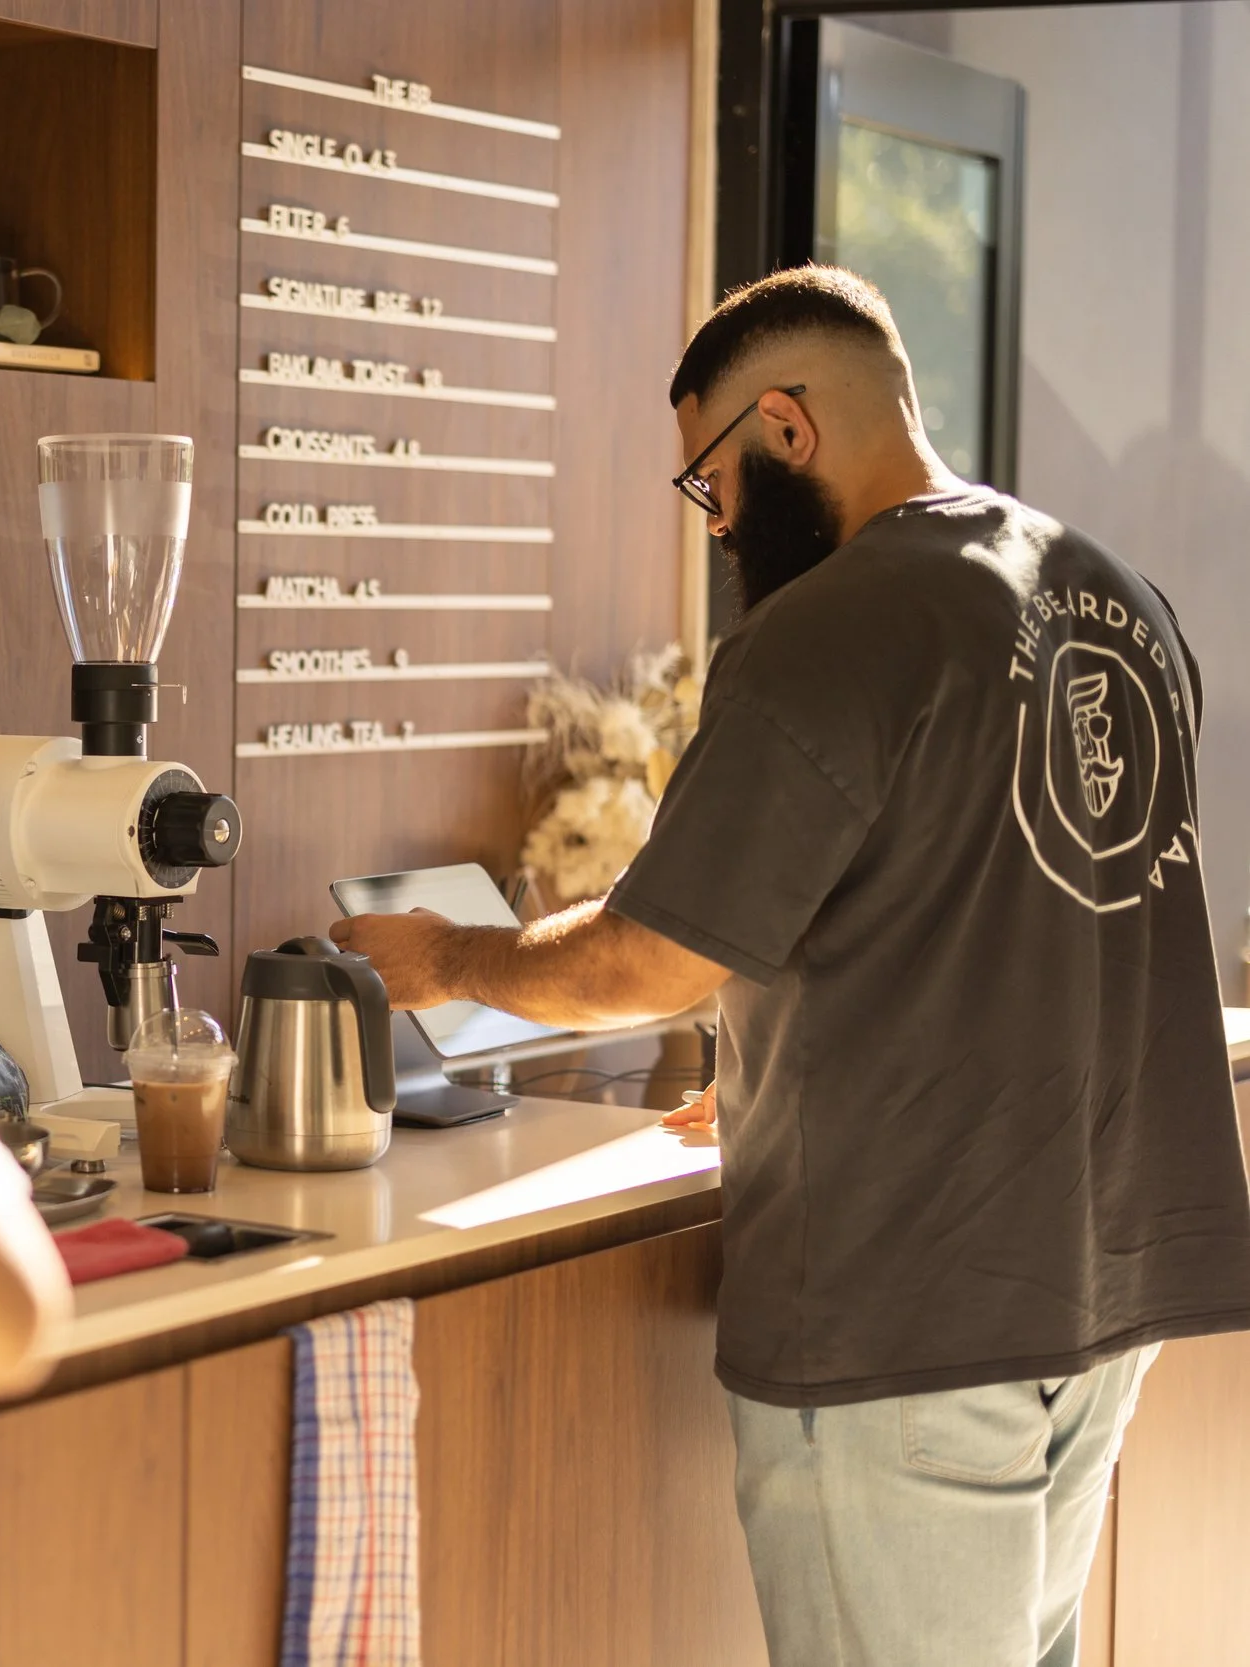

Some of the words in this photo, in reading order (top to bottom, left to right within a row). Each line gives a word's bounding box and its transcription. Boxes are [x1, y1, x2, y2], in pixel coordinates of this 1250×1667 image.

[372, 74, 408, 105] THE
[269, 129, 337, 162] SINGLE
[269, 204, 326, 235] FILTER
[268, 277, 367, 312] SIGNATURE
[352, 360, 409, 389] TOAST
[267, 426, 377, 458] CROISSANTS
[266, 503, 319, 528] COLD
[327, 505, 379, 529] PRESS
[266, 576, 342, 601] MATCHA
[1009, 611, 1041, 682] THE
[1032, 586, 1167, 670] BEARDED
[269, 648, 374, 675] SMOOTHIES
[267, 721, 343, 748] HEALING
[350, 720, 384, 746] TEA
